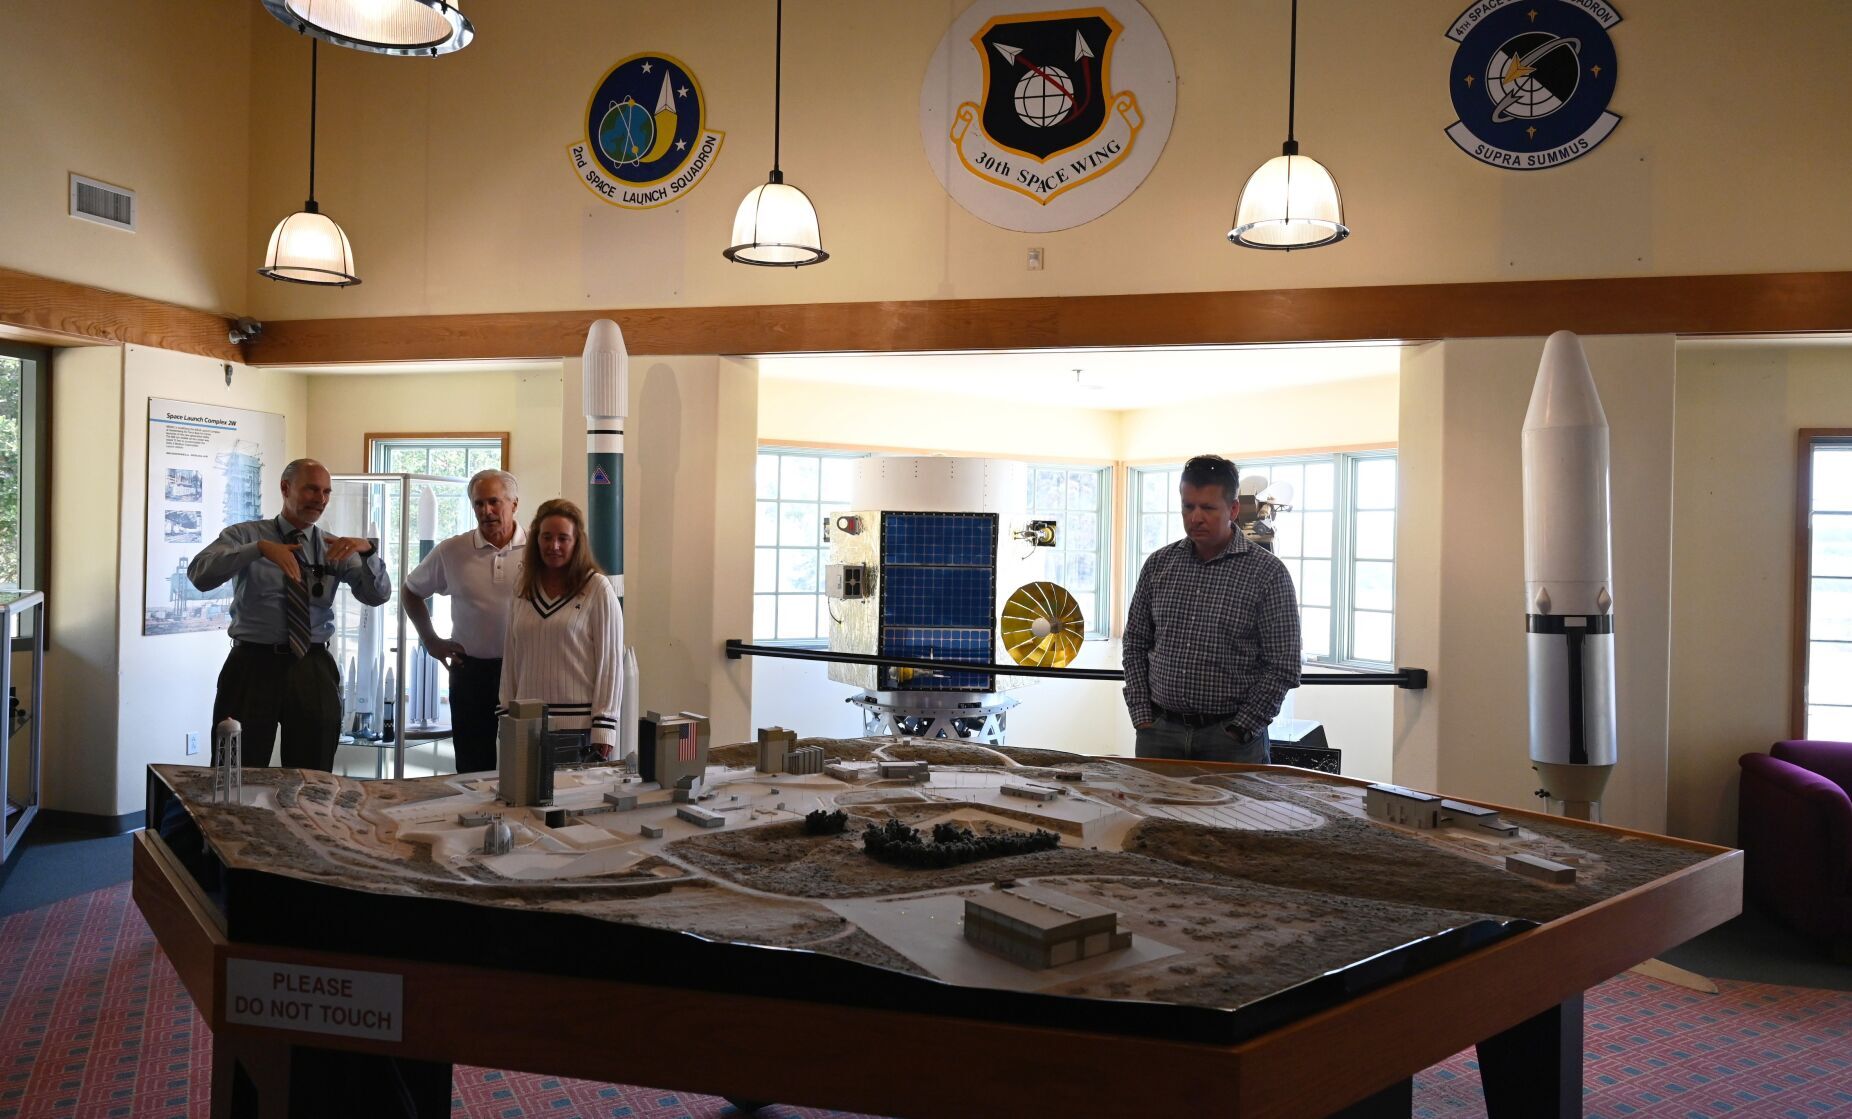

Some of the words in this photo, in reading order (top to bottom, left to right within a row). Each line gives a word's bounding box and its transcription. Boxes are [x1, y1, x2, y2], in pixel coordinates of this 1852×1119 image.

[1571, 0, 1613, 23] ADRON
[975, 151, 1011, 176] 30th
[1017, 168, 1069, 193] SPACE
[1071, 139, 1121, 175] WING
[1474, 144, 1521, 166] SUPRA
[1527, 138, 1589, 166] SUMMUS
[573, 146, 587, 169] 2nd
[586, 170, 617, 198] SPACE
[623, 187, 667, 205] LAUNCH
[670, 135, 717, 193] SQUADRON
[184, 414, 203, 422] Launch
[273, 972, 353, 998] PLEASE
[235, 996, 264, 1016] DO
[270, 1000, 313, 1021] NOT
[319, 1005, 392, 1031] TOUCH
